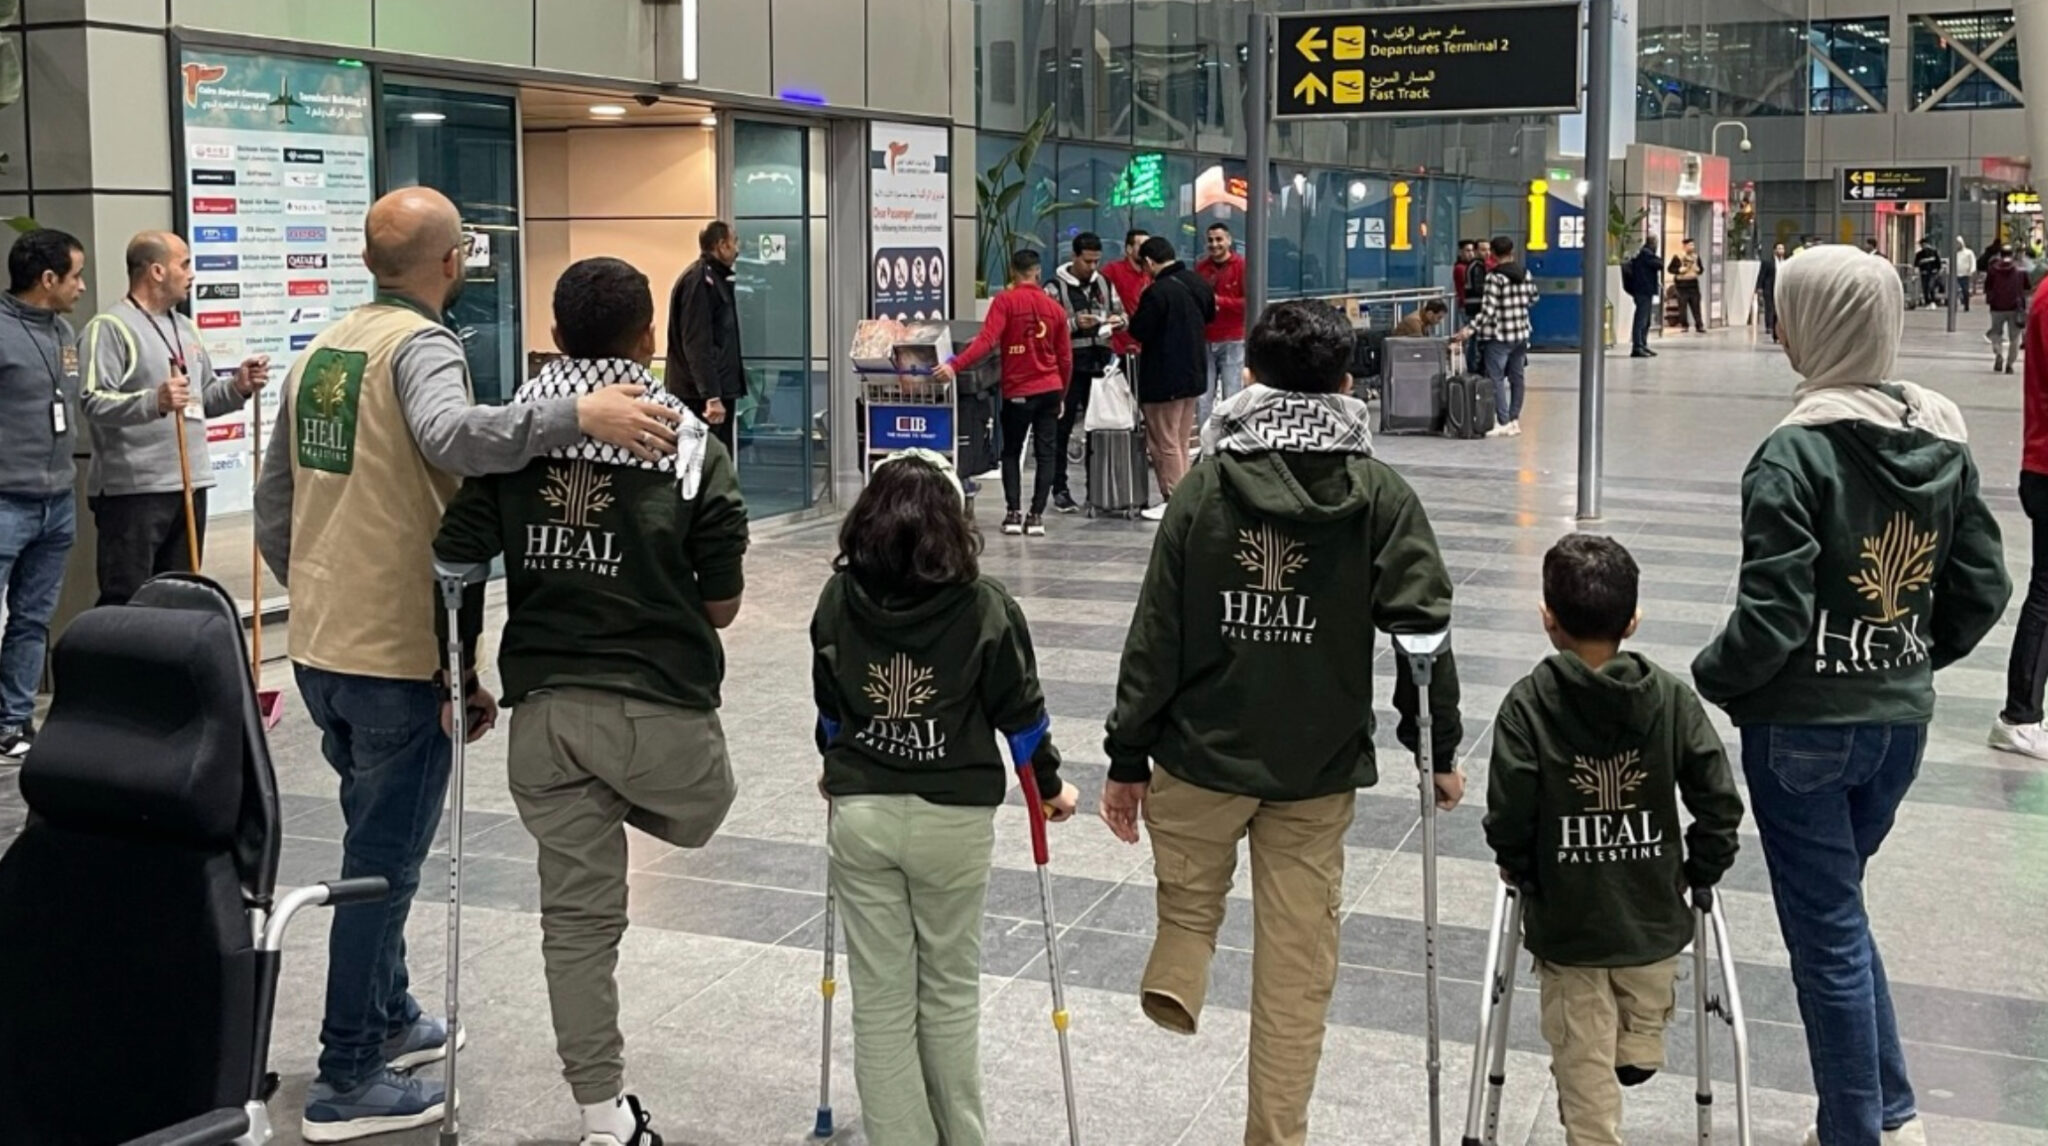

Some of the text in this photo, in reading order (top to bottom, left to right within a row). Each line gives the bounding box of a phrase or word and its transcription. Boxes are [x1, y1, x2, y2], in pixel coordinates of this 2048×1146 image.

[1370, 39, 1509, 58] Departures Terminal 2
[1369, 87, 1430, 100] Fast Track
[896, 416, 927, 432] CIB
[302, 418, 347, 451] HEAL
[525, 524, 622, 563] HEAL
[524, 559, 619, 577] PALESTINE
[1219, 591, 1316, 630] HEAL
[1221, 625, 1313, 644] PALESTINE
[1559, 810, 1662, 848] HEAL
[1558, 845, 1662, 862] PALESTINE
